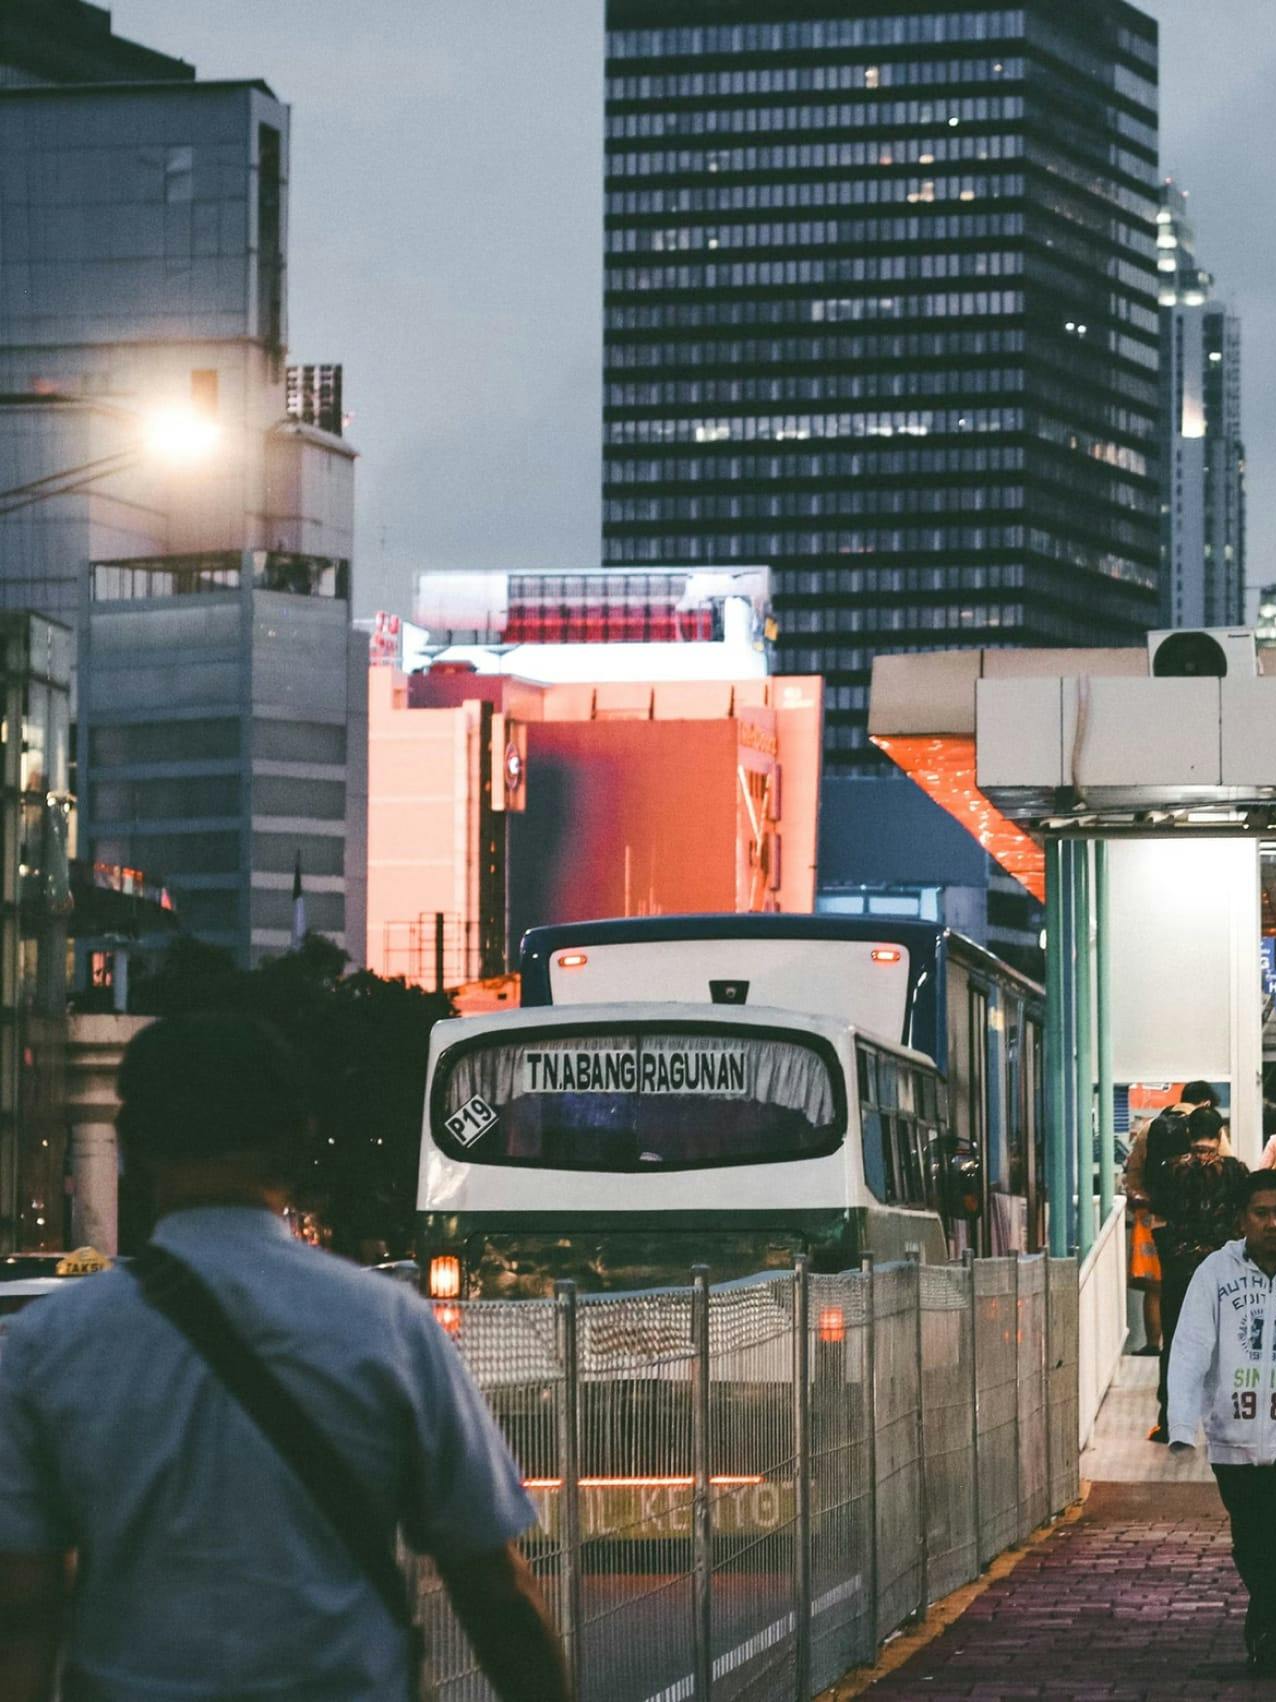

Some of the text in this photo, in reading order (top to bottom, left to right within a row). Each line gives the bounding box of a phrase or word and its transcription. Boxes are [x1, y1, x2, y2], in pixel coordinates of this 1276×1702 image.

[527, 1053, 745, 1091] TN.ABANG RAGUNAN
[448, 1100, 492, 1142] P19
